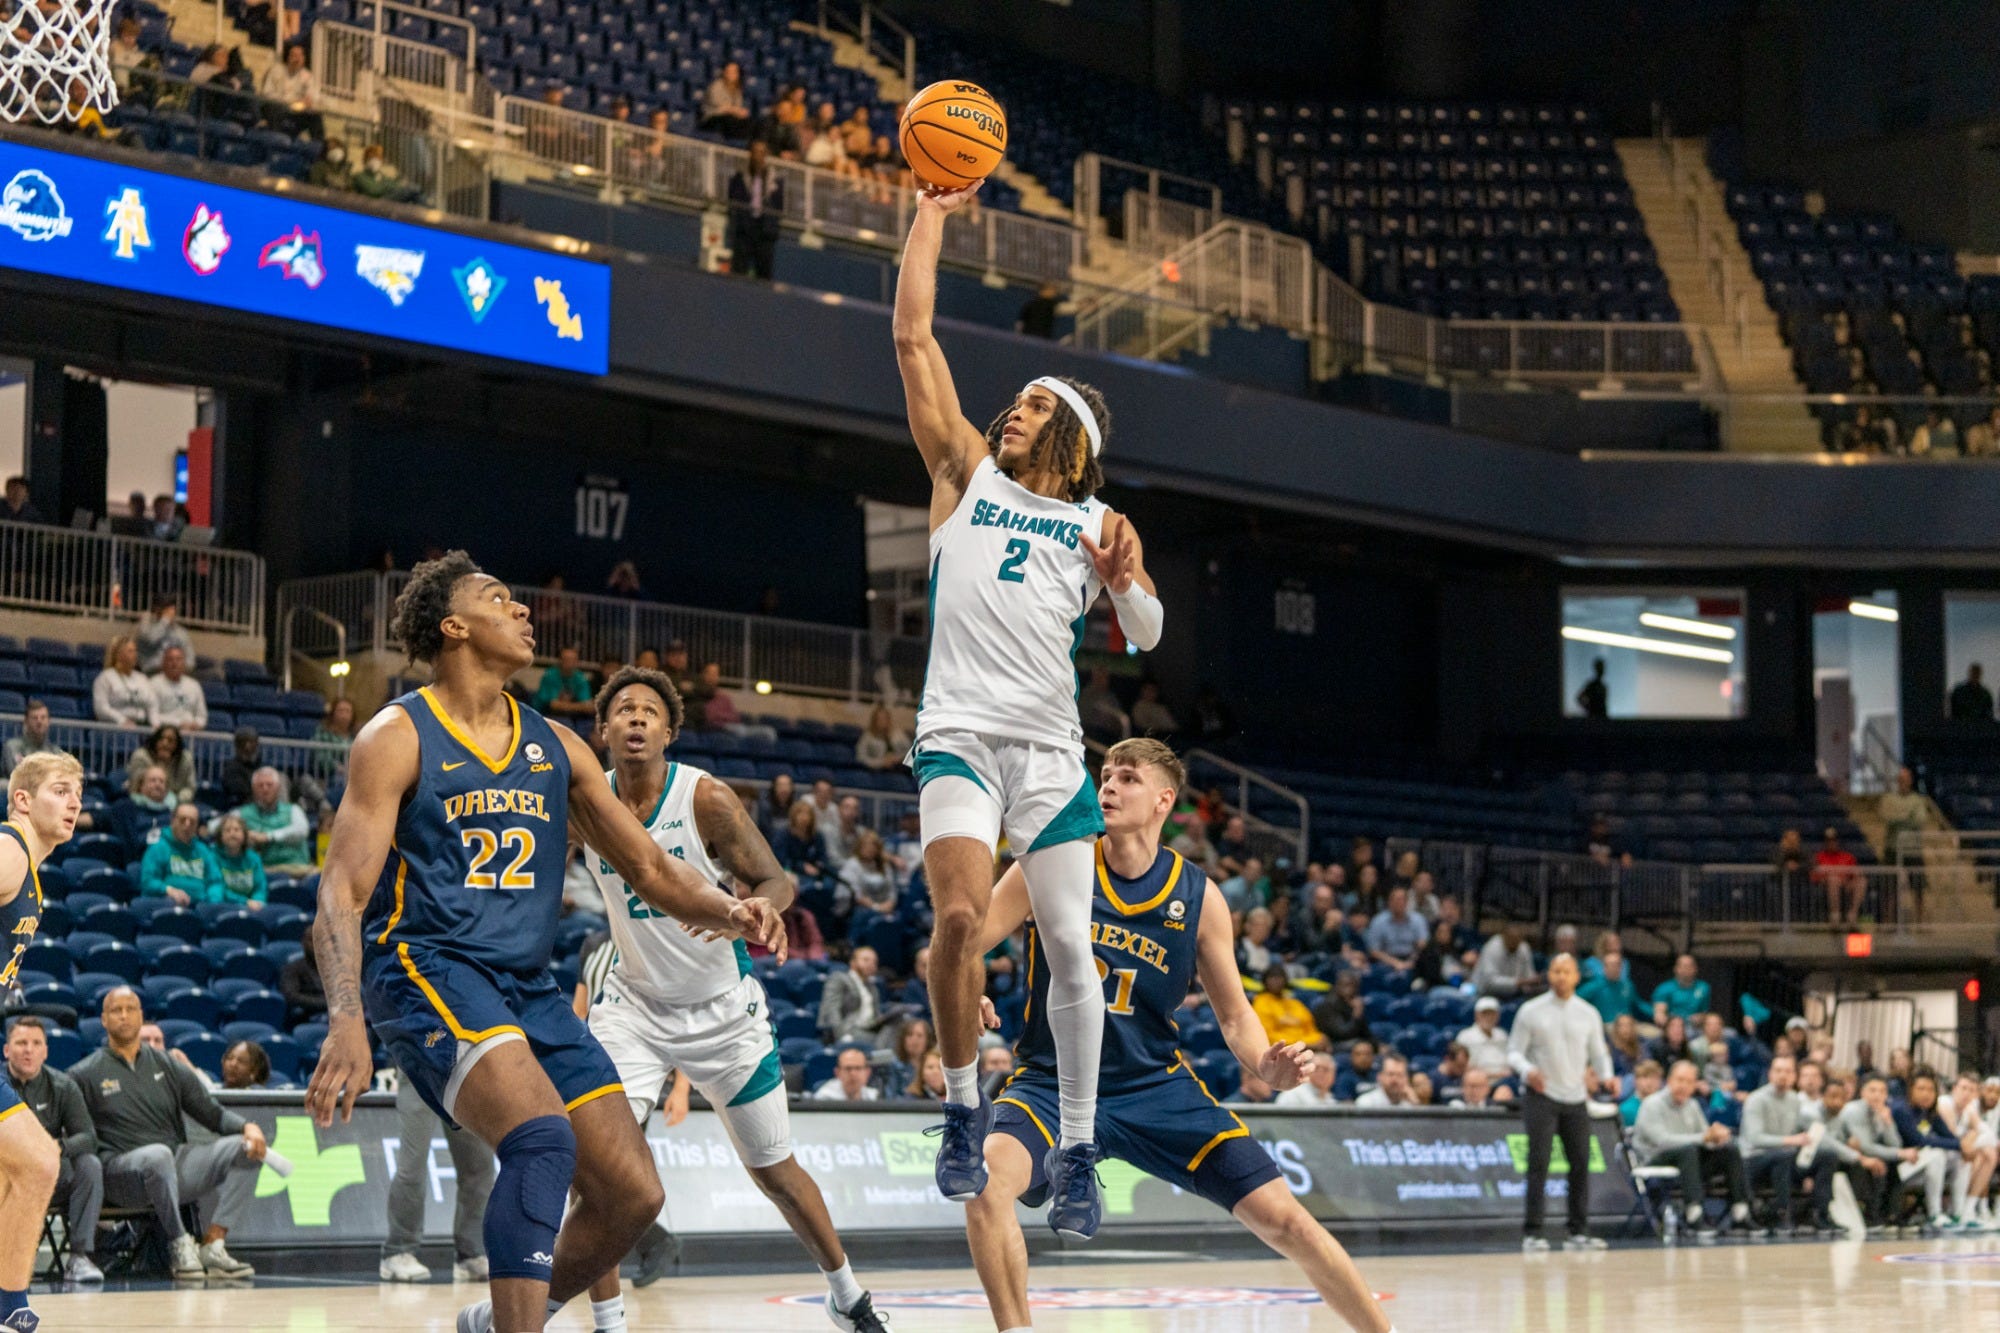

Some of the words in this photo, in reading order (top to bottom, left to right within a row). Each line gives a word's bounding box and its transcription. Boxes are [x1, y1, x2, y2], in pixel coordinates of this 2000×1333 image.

[946, 105, 1004, 143] Wilson
[576, 488, 629, 541] 107
[970, 498, 1083, 551] SEAHAWKS
[998, 538, 1031, 583] 2
[530, 762, 554, 773] CAA
[444, 788, 550, 823] DREXEL
[661, 819, 683, 831] CAA
[461, 827, 536, 889] 22
[1163, 920, 1185, 931] CAA
[650, 1138, 699, 1167] This
[889, 1139, 941, 1164] Sho
